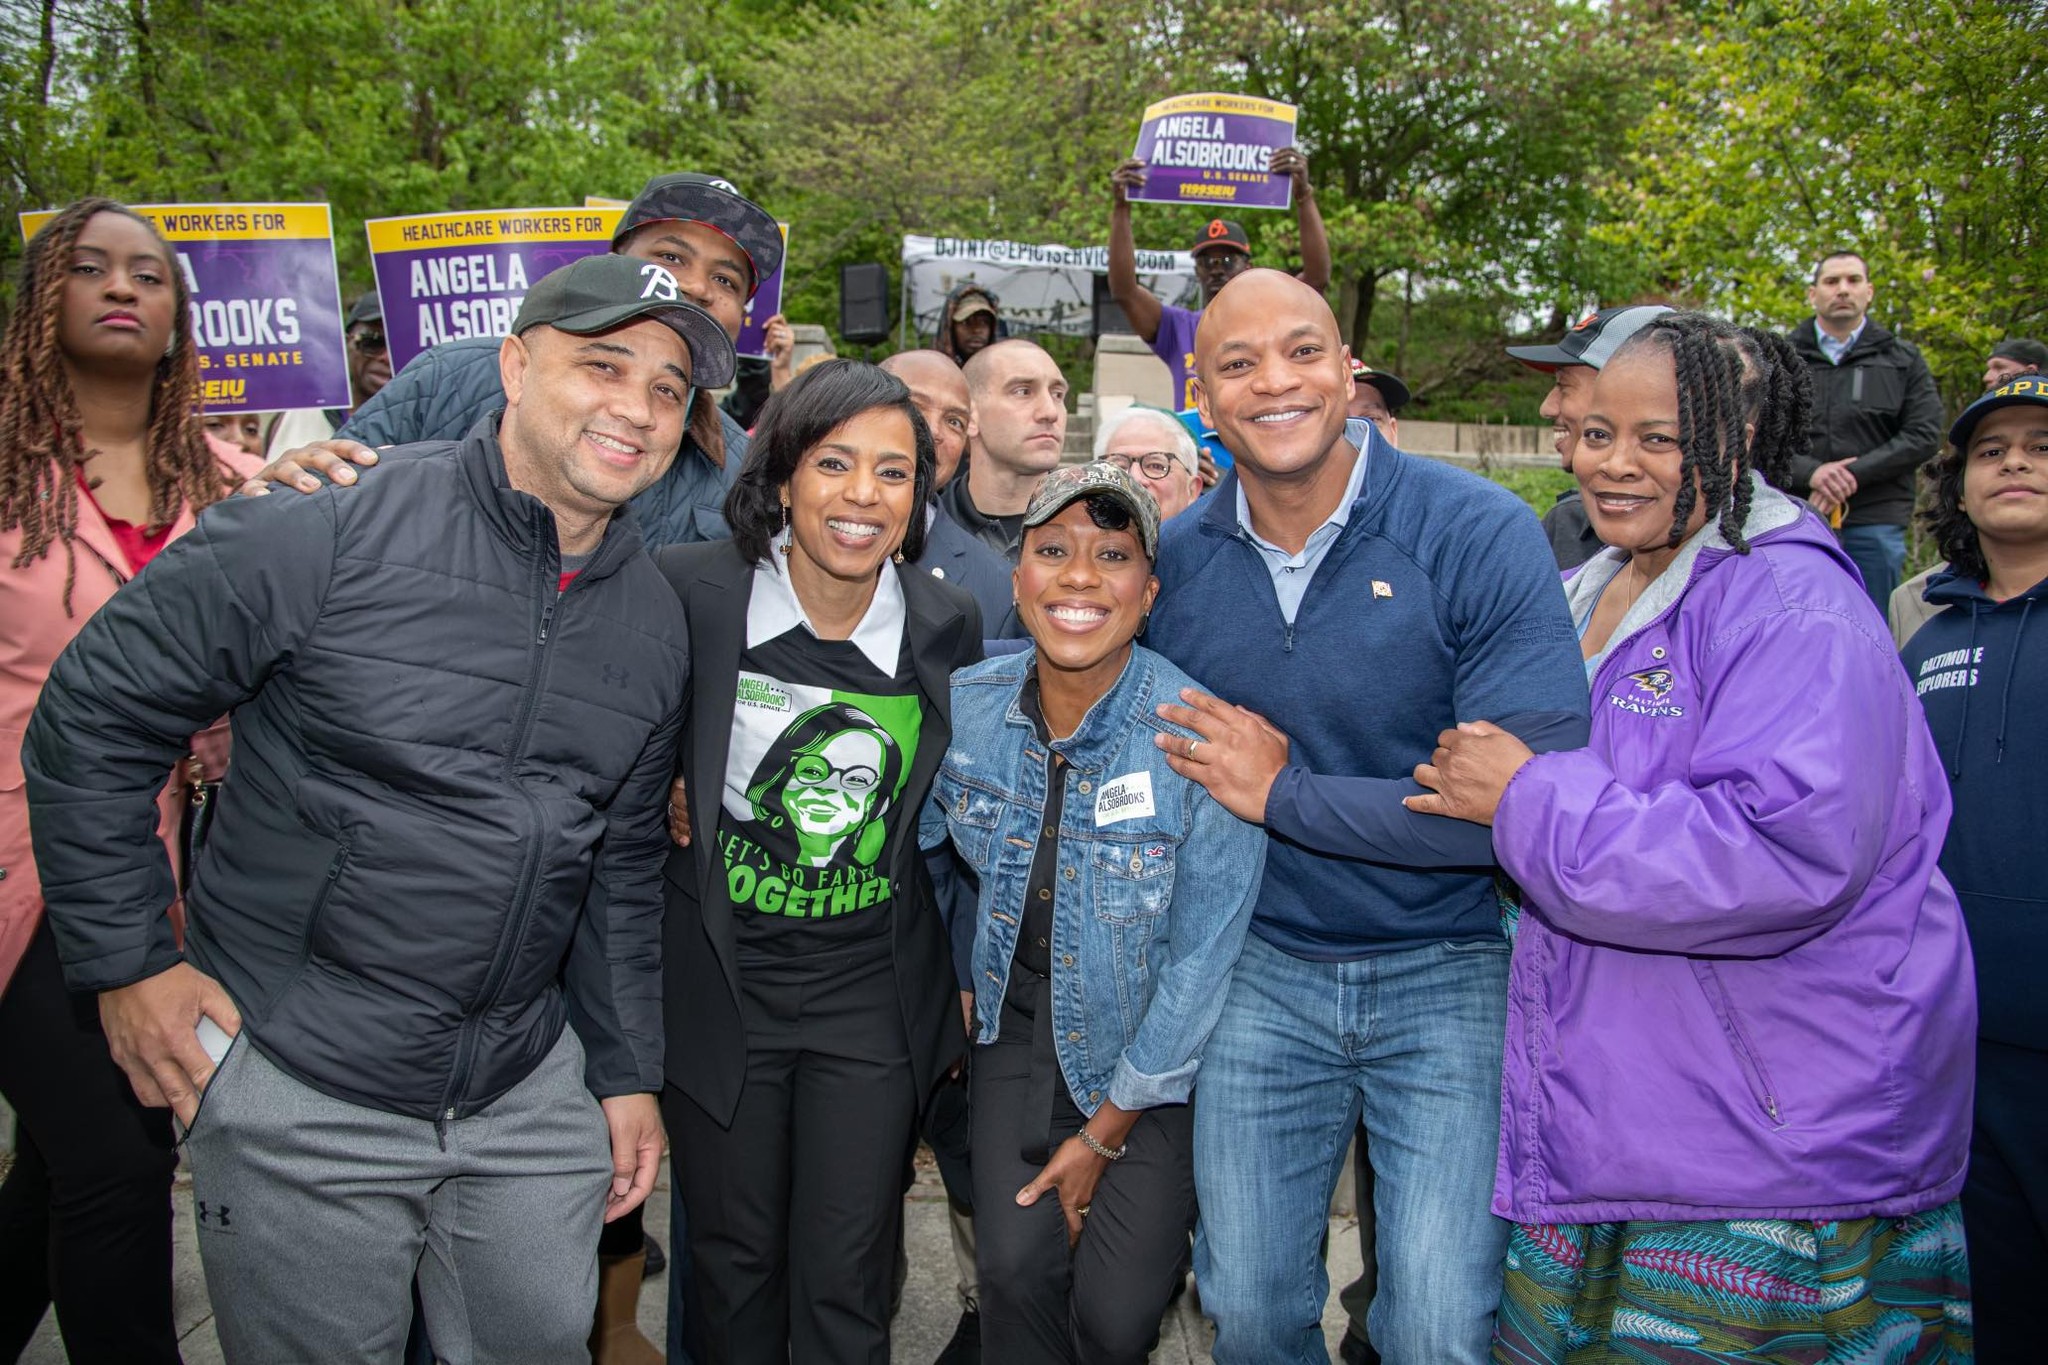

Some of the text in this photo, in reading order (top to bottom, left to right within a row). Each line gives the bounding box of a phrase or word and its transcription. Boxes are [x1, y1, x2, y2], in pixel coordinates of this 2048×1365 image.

[1155, 116, 1225, 140] ANGELA
[1152, 139, 1272, 172] ALSOBROOKS
[1228, 172, 1269, 184] SENATE
[163, 214, 247, 232] WORKERS
[253, 213, 286, 231] FOR
[402, 216, 603, 241] HEALTHCARE WORKERS FOR
[411, 253, 529, 298] ANGELA
[189, 297, 301, 347] ROOKS
[419, 297, 525, 347] ALSOB
[225, 351, 303, 368] SENATE
[1088, 471, 1121, 485] FARM
[738, 678, 770, 692] ANGELA
[1917, 669, 1979, 696] EXPLORERS
[737, 689, 785, 707] ALSOBROOKS
[760, 703, 781, 712] SENATE
[1610, 694, 1684, 717] RAVENS
[1098, 791, 1145, 812] ALSOBROOKS
[1101, 783, 1126, 801] ANGELA
[780, 862, 805, 888] GO
[724, 857, 891, 918] OGETHER
